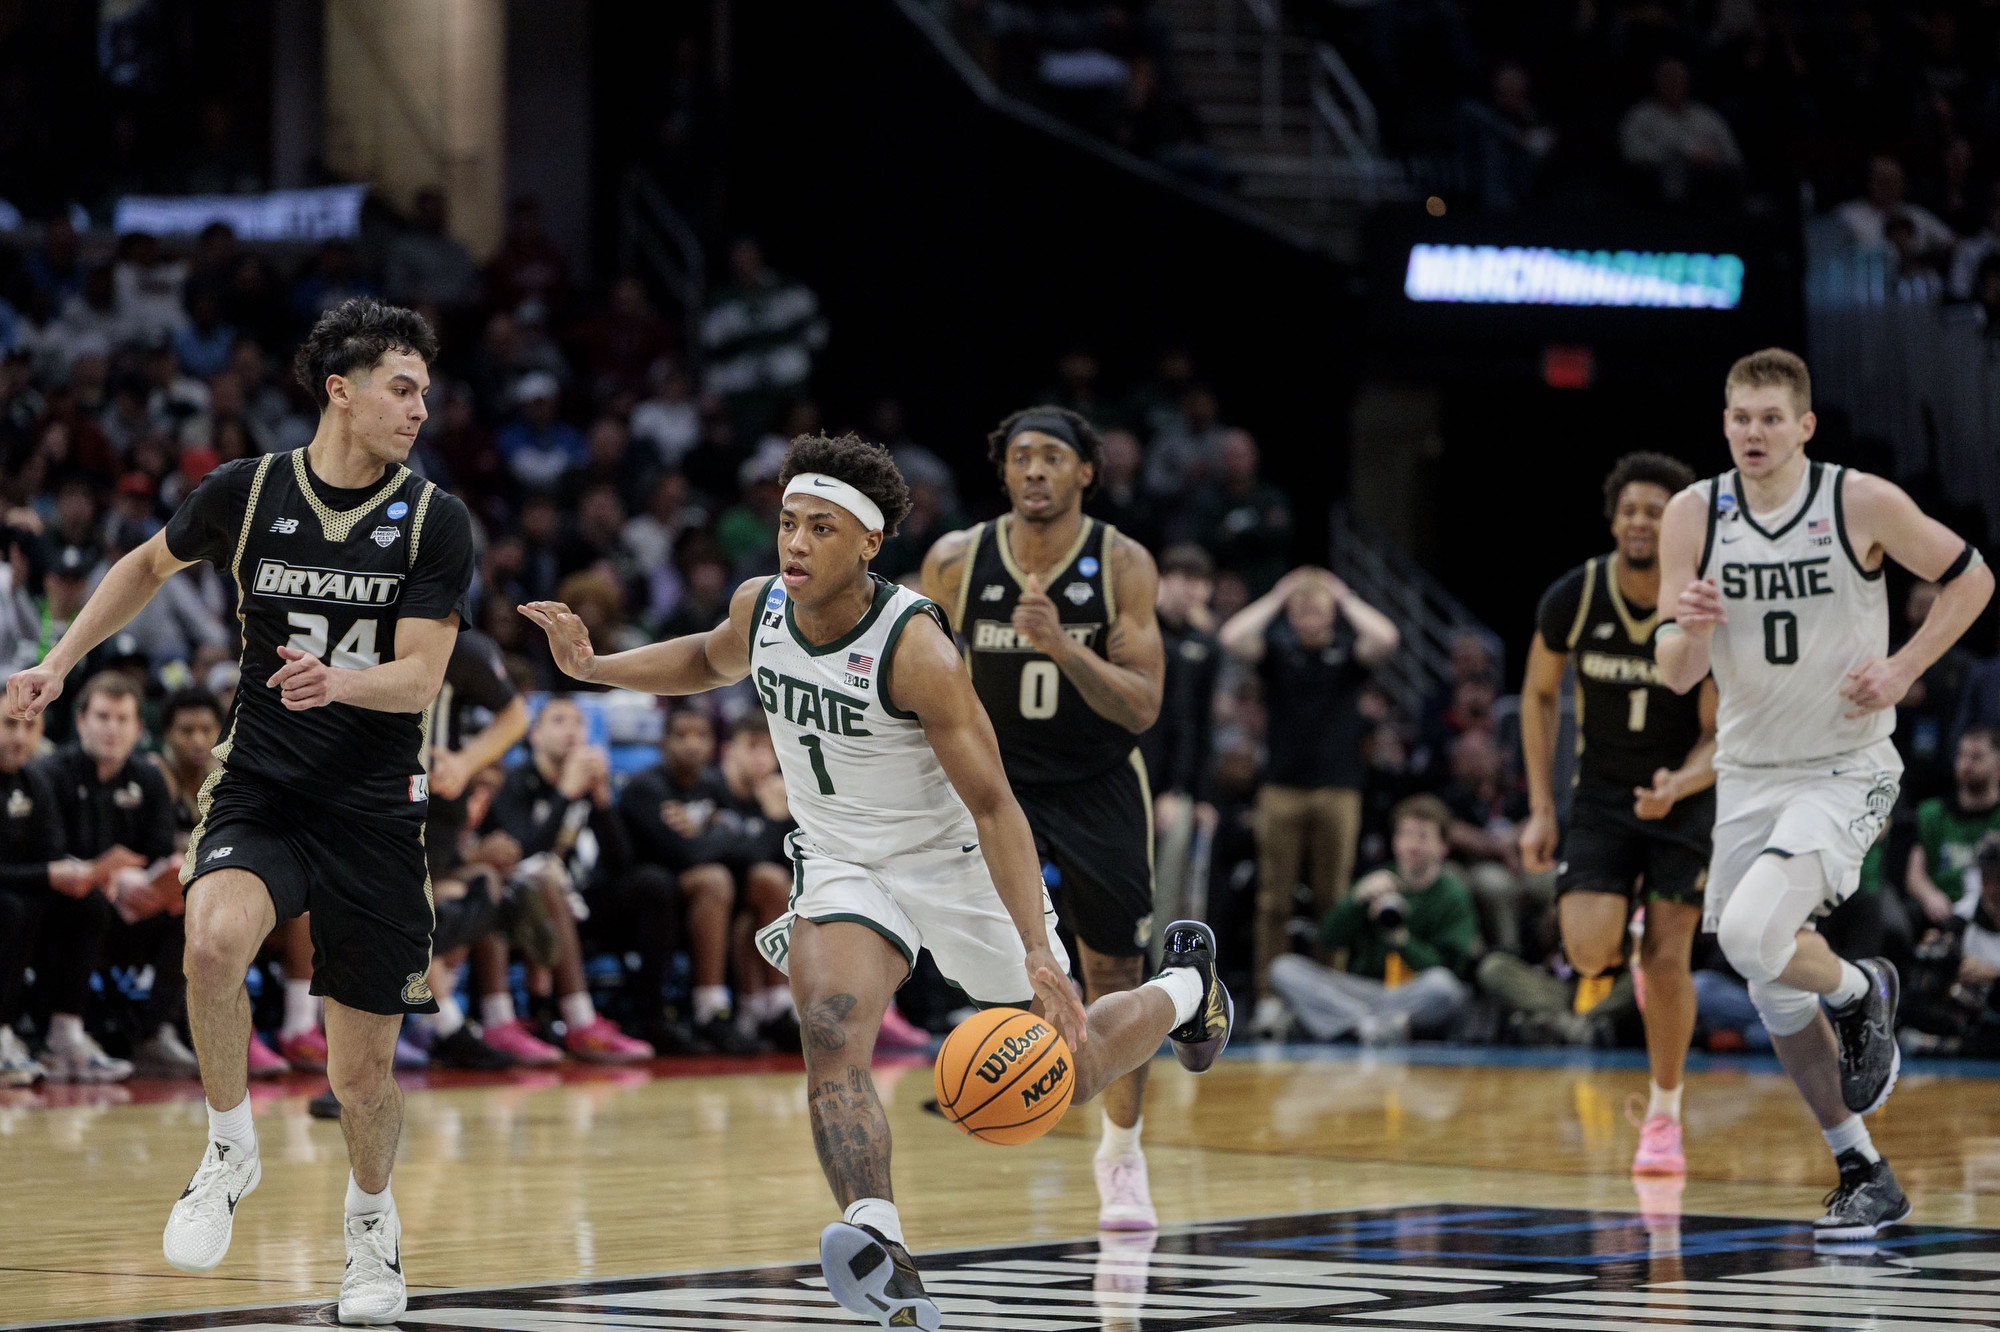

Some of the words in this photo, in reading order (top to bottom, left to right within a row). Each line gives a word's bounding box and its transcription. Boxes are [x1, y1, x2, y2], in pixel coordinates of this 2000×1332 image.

[255, 562, 398, 603] BRYANT
[1722, 555, 1835, 601] STATE
[285, 611, 381, 671] 24
[1763, 611, 1799, 665] 0
[757, 665, 874, 737] STATE
[1019, 660, 1060, 720] 0
[1628, 687, 1649, 732] 1
[798, 734, 836, 795] 1
[975, 1023, 1050, 1084] Wilson
[822, 1080, 846, 1094] The
[1020, 1056, 1068, 1109] NCAA
